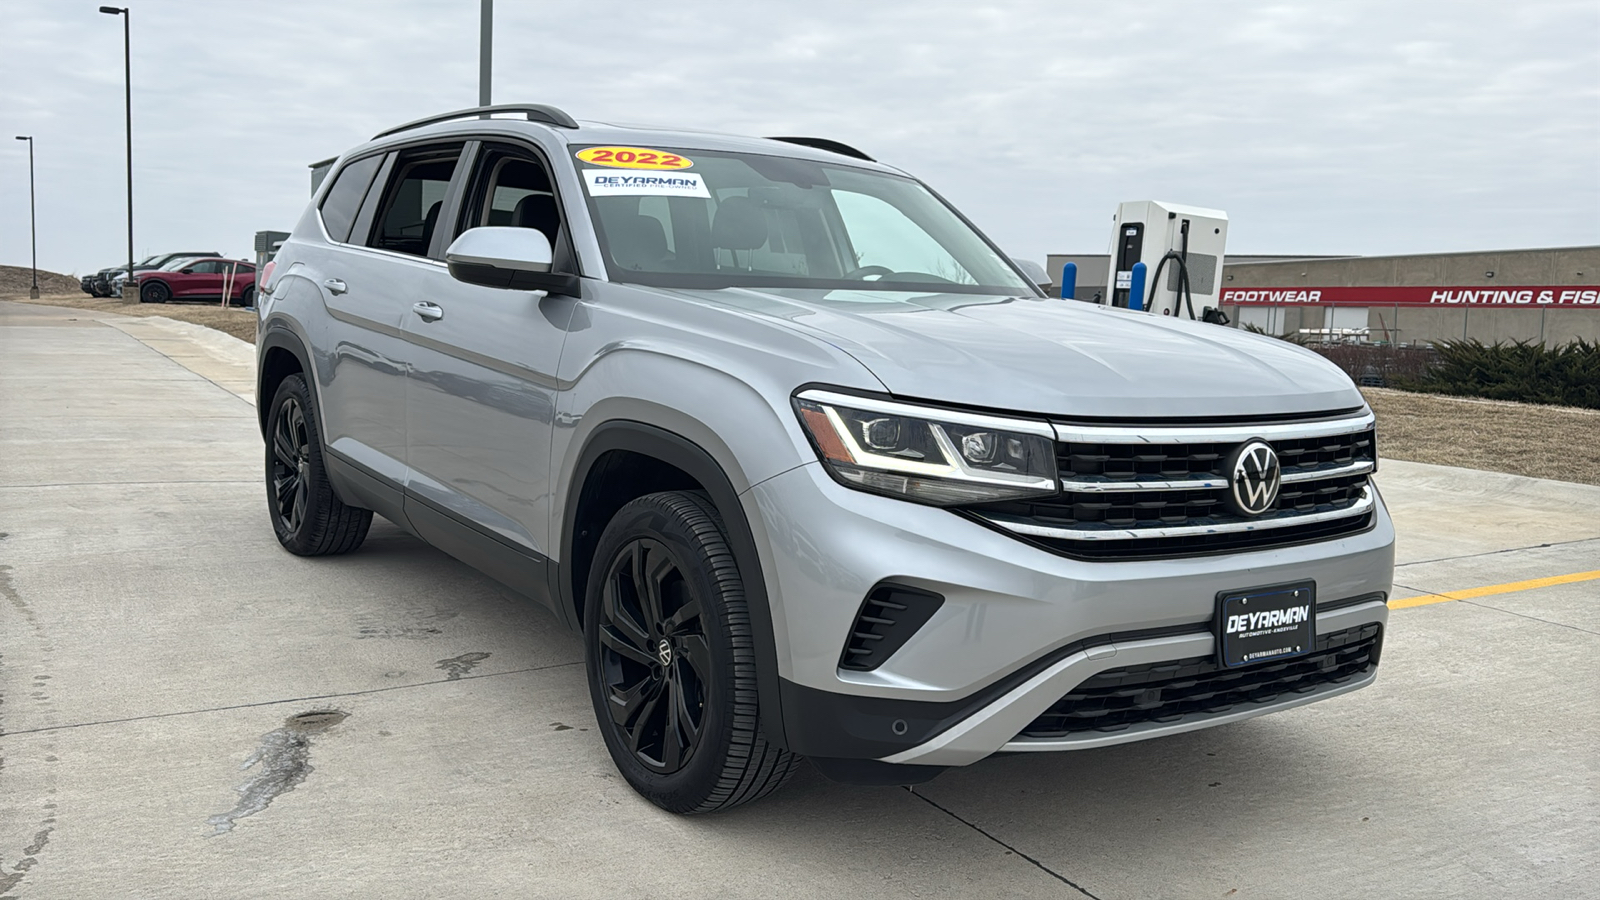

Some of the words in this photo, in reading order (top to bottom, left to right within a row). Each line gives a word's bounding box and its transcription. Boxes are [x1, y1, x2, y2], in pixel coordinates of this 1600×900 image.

[591, 150, 682, 167] 2022
[594, 176, 697, 186] DEYARMAN
[1223, 291, 1322, 302] FOOTWEAR
[1429, 290, 1534, 304] HUNTING
[1536, 290, 1554, 304] &
[1226, 605, 1310, 634] DEYARMAN
